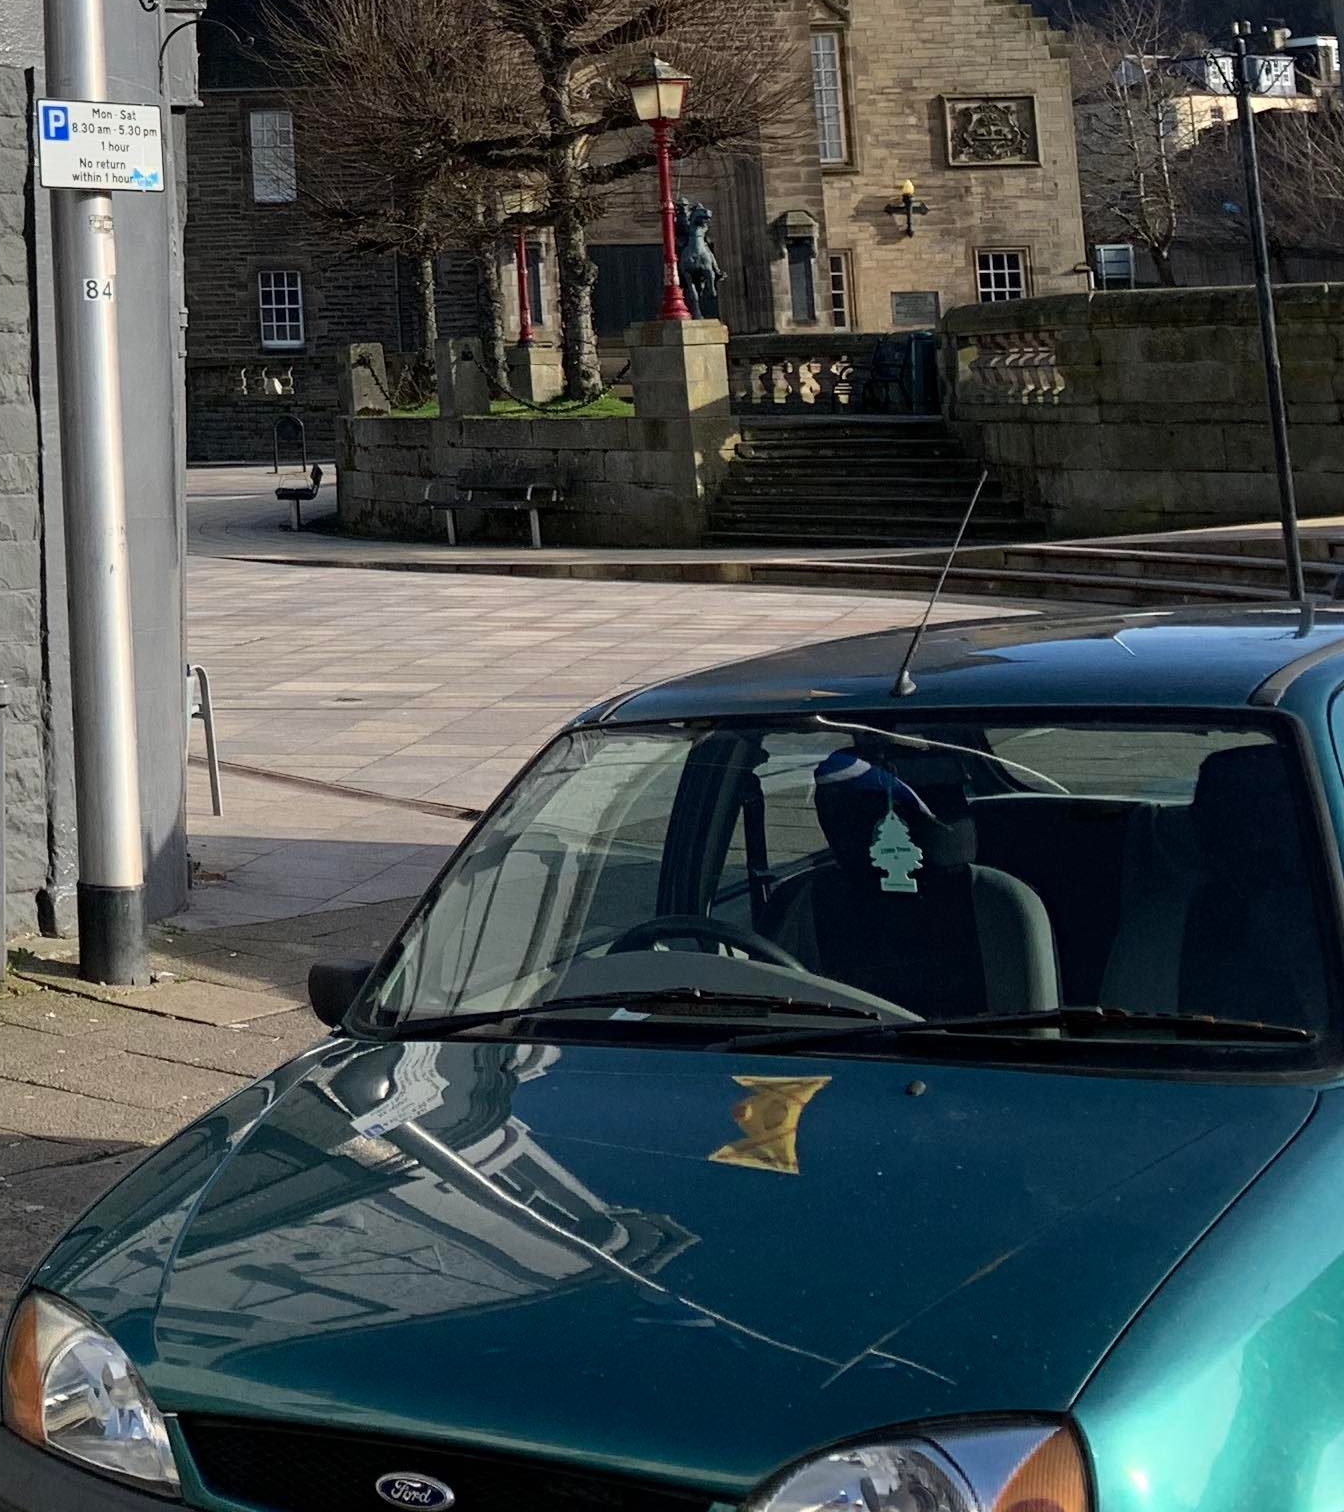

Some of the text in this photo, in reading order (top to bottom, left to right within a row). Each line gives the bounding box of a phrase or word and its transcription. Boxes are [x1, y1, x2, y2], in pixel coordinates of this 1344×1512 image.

[92, 108, 113, 120] Mon
[120, 110, 137, 121] Sat
[48, 109, 66, 138] P
[72, 122, 95, 135] 8.30
[96, 126, 112, 135] am
[118, 123, 141, 136] 5.30
[143, 128, 158, 139] pm
[108, 142, 130, 152] hour
[79, 158, 126, 170] No return
[72, 170, 102, 183] within
[112, 172, 133, 184] hour
[85, 279, 113, 300] 84
[390, 1479, 432, 1504] Ford
